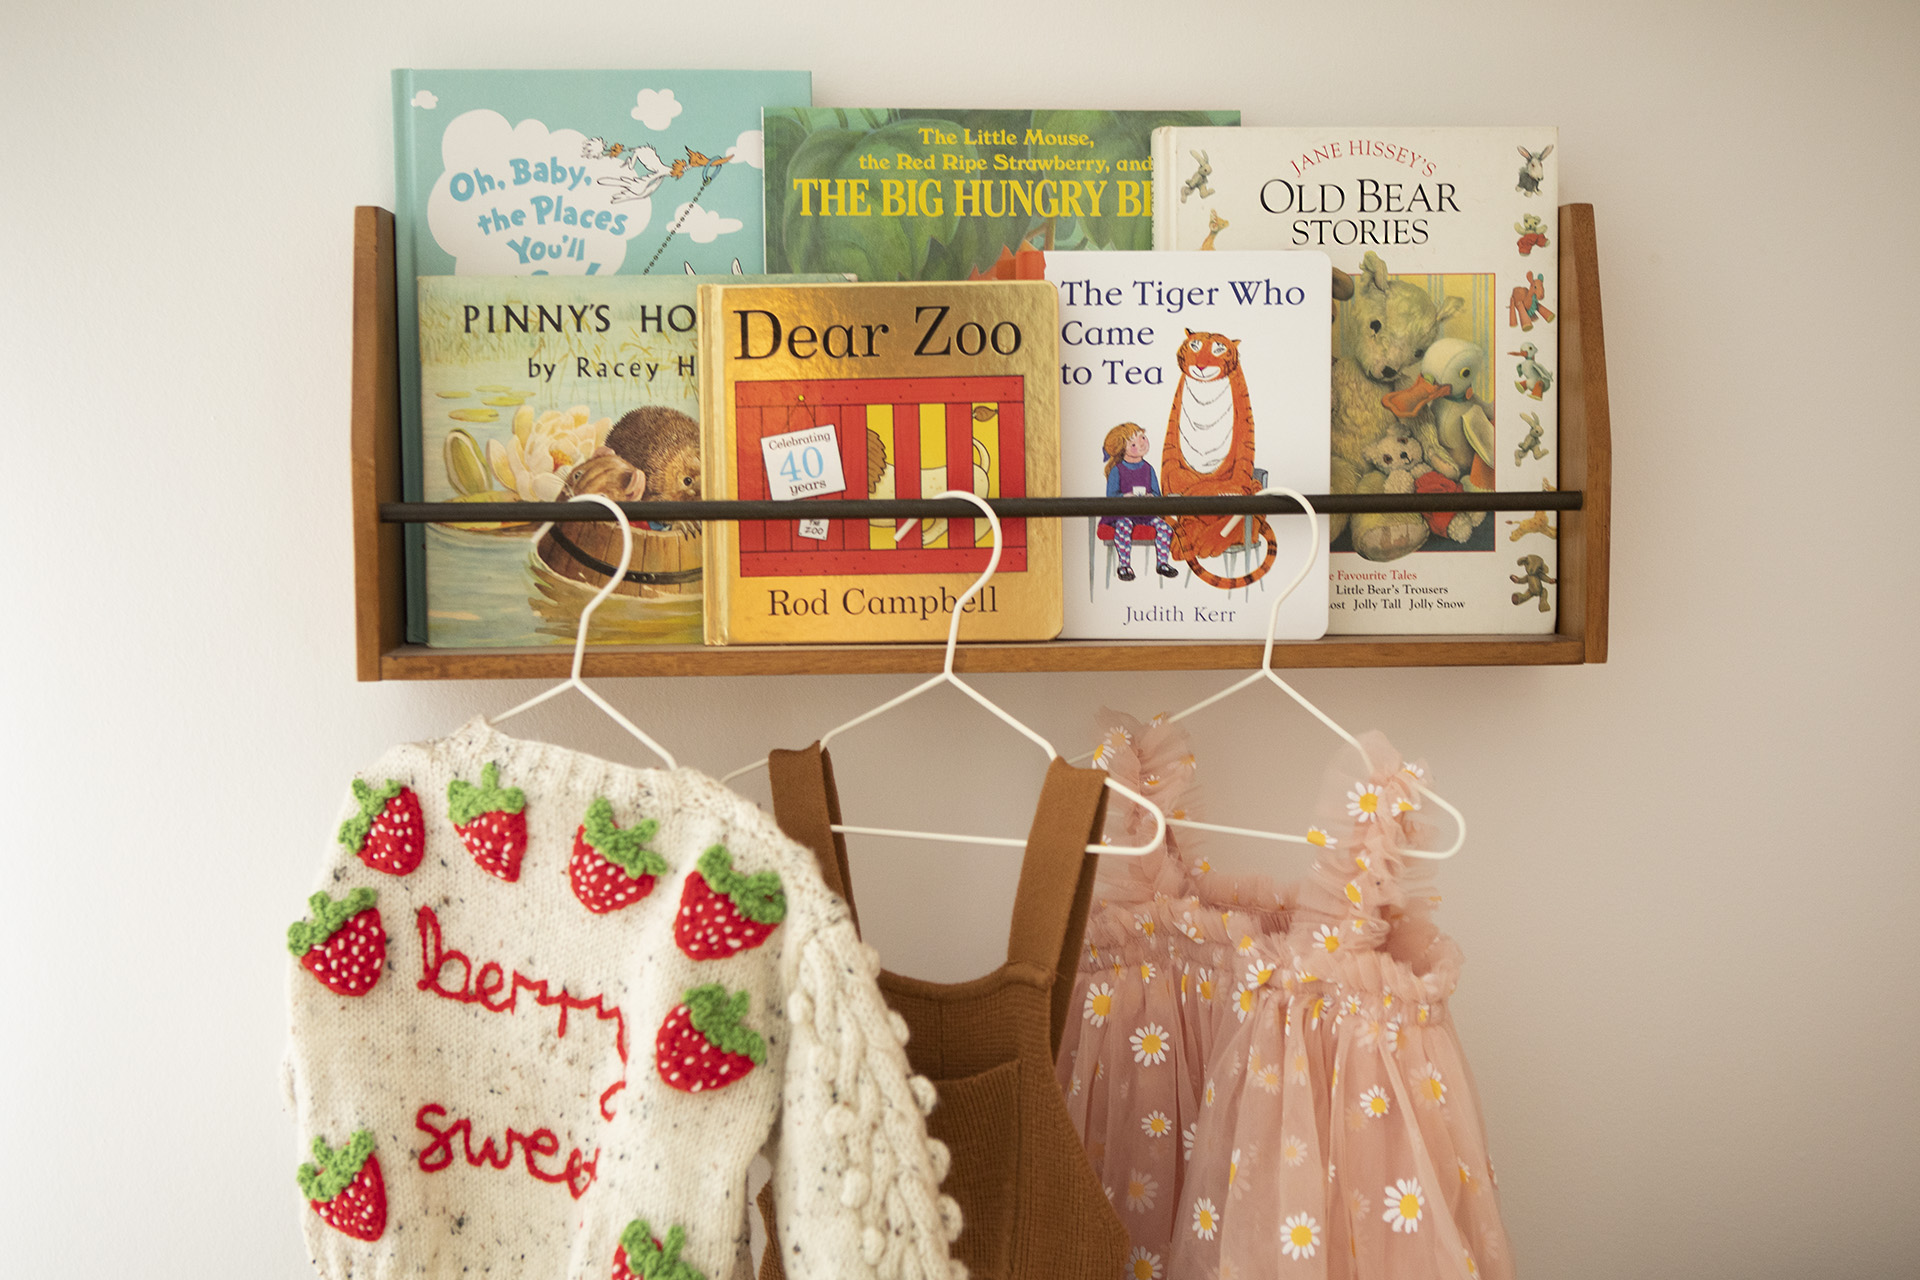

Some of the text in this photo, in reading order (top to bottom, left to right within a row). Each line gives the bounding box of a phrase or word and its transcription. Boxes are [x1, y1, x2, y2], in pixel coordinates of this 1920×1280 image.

[918, 128, 1095, 148] The Little Mouse,
[859, 154, 1151, 173] the Red Ripe Strawberry, and
[1290, 139, 1437, 178] JANE HISSEY'S
[449, 156, 592, 202] Oh, Baby,
[793, 178, 872, 217] THE
[880, 178, 944, 217] BIG
[953, 179, 1108, 218] HUNGRY
[477, 195, 628, 236] the Places
[1291, 219, 1430, 246] STORIES
[506, 235, 585, 264] You'll
[1060, 278, 1306, 314] The Tiger Who
[463, 303, 697, 334] PINNY'S HO
[733, 306, 1022, 360] Dear Zoo
[1061, 320, 1155, 346] Came
[528, 357, 556, 383] by
[577, 356, 659, 383] Racey
[1061, 359, 1164, 386] to Tea
[768, 432, 831, 451] Celebrating
[780, 446, 824, 482] 40
[789, 480, 827, 496] years
[1337, 570, 1387, 581] Favourite
[1390, 570, 1418, 581] Tales
[767, 586, 999, 620] Rod Campbell
[1336, 584, 1449, 595] Little Bear's Trousers
[1123, 605, 1237, 626] Judith Kerr
[1329, 598, 1466, 612] ost Jolly Tall Jolly Snow
